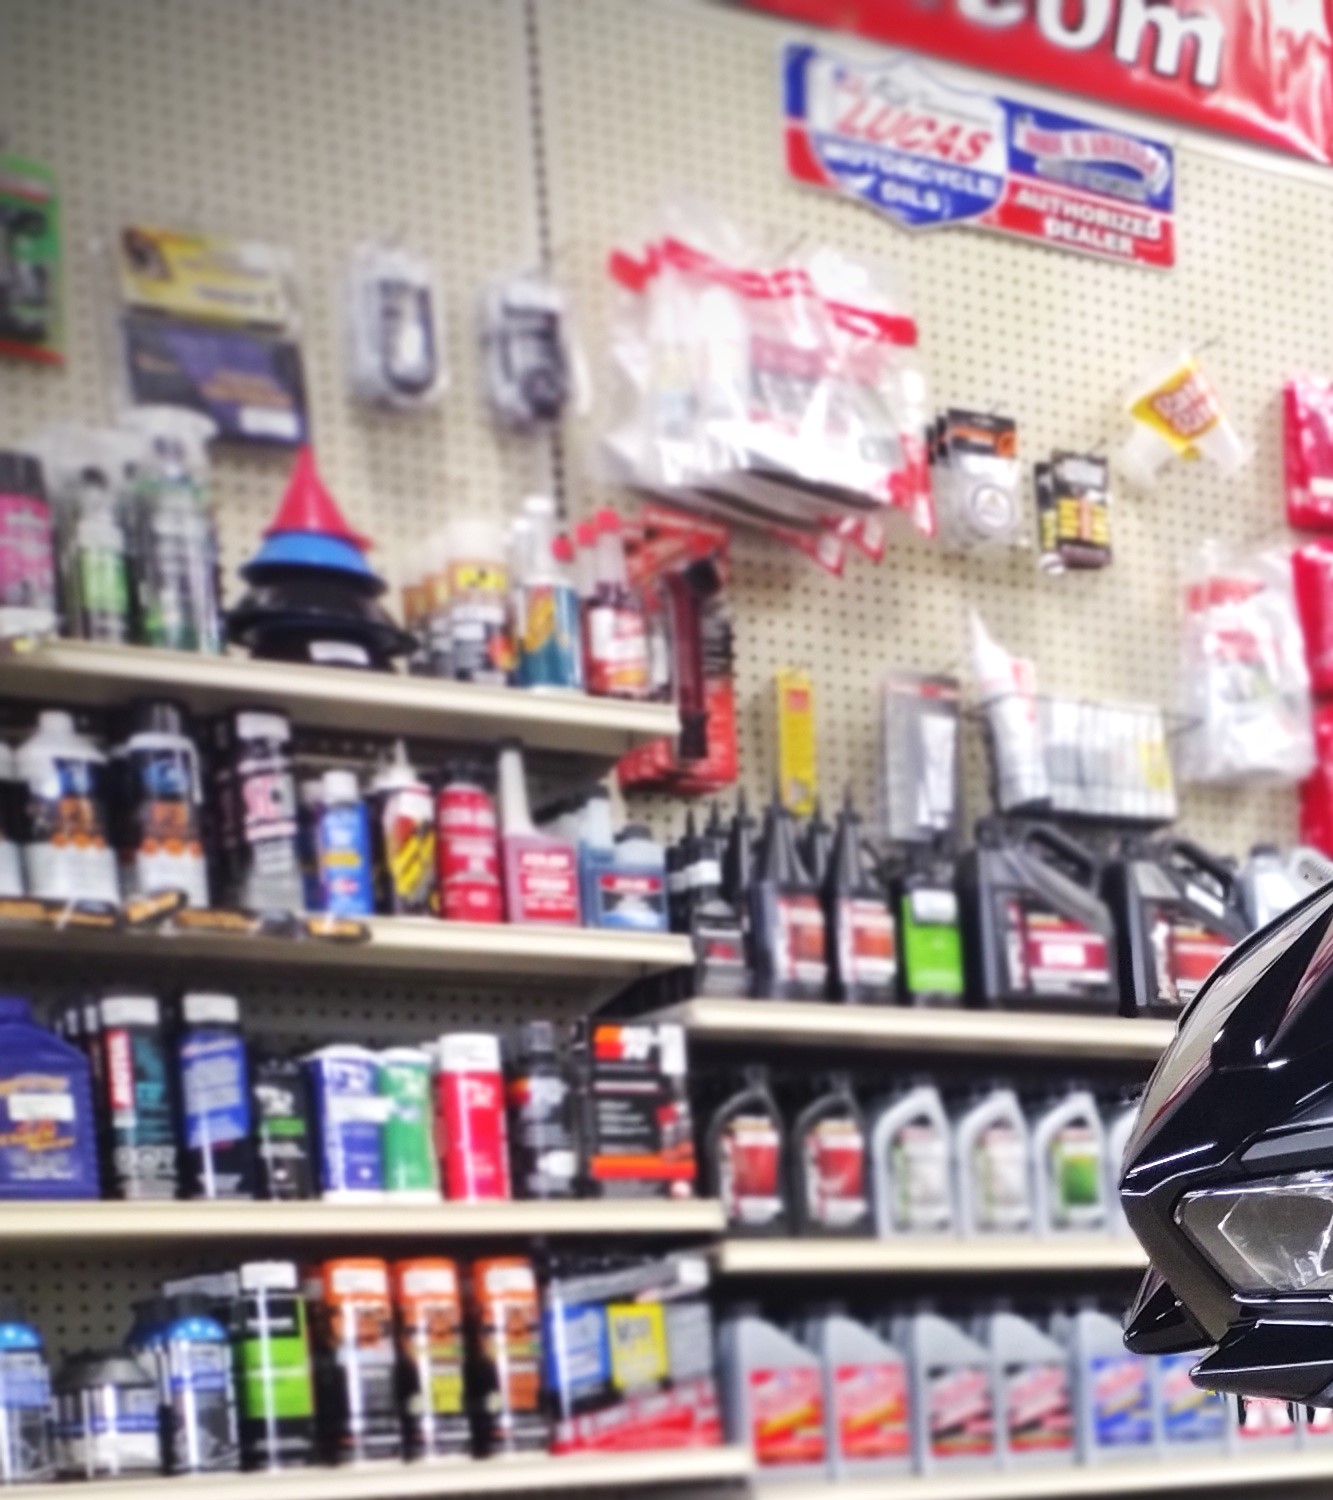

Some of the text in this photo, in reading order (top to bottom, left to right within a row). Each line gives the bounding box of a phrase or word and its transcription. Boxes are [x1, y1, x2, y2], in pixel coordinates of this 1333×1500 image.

[836, 97, 993, 165] LUCAS
[880, 178, 942, 212] OILS
[1014, 187, 1161, 240] AUTHORIZED
[1044, 217, 1134, 258] DEALER
